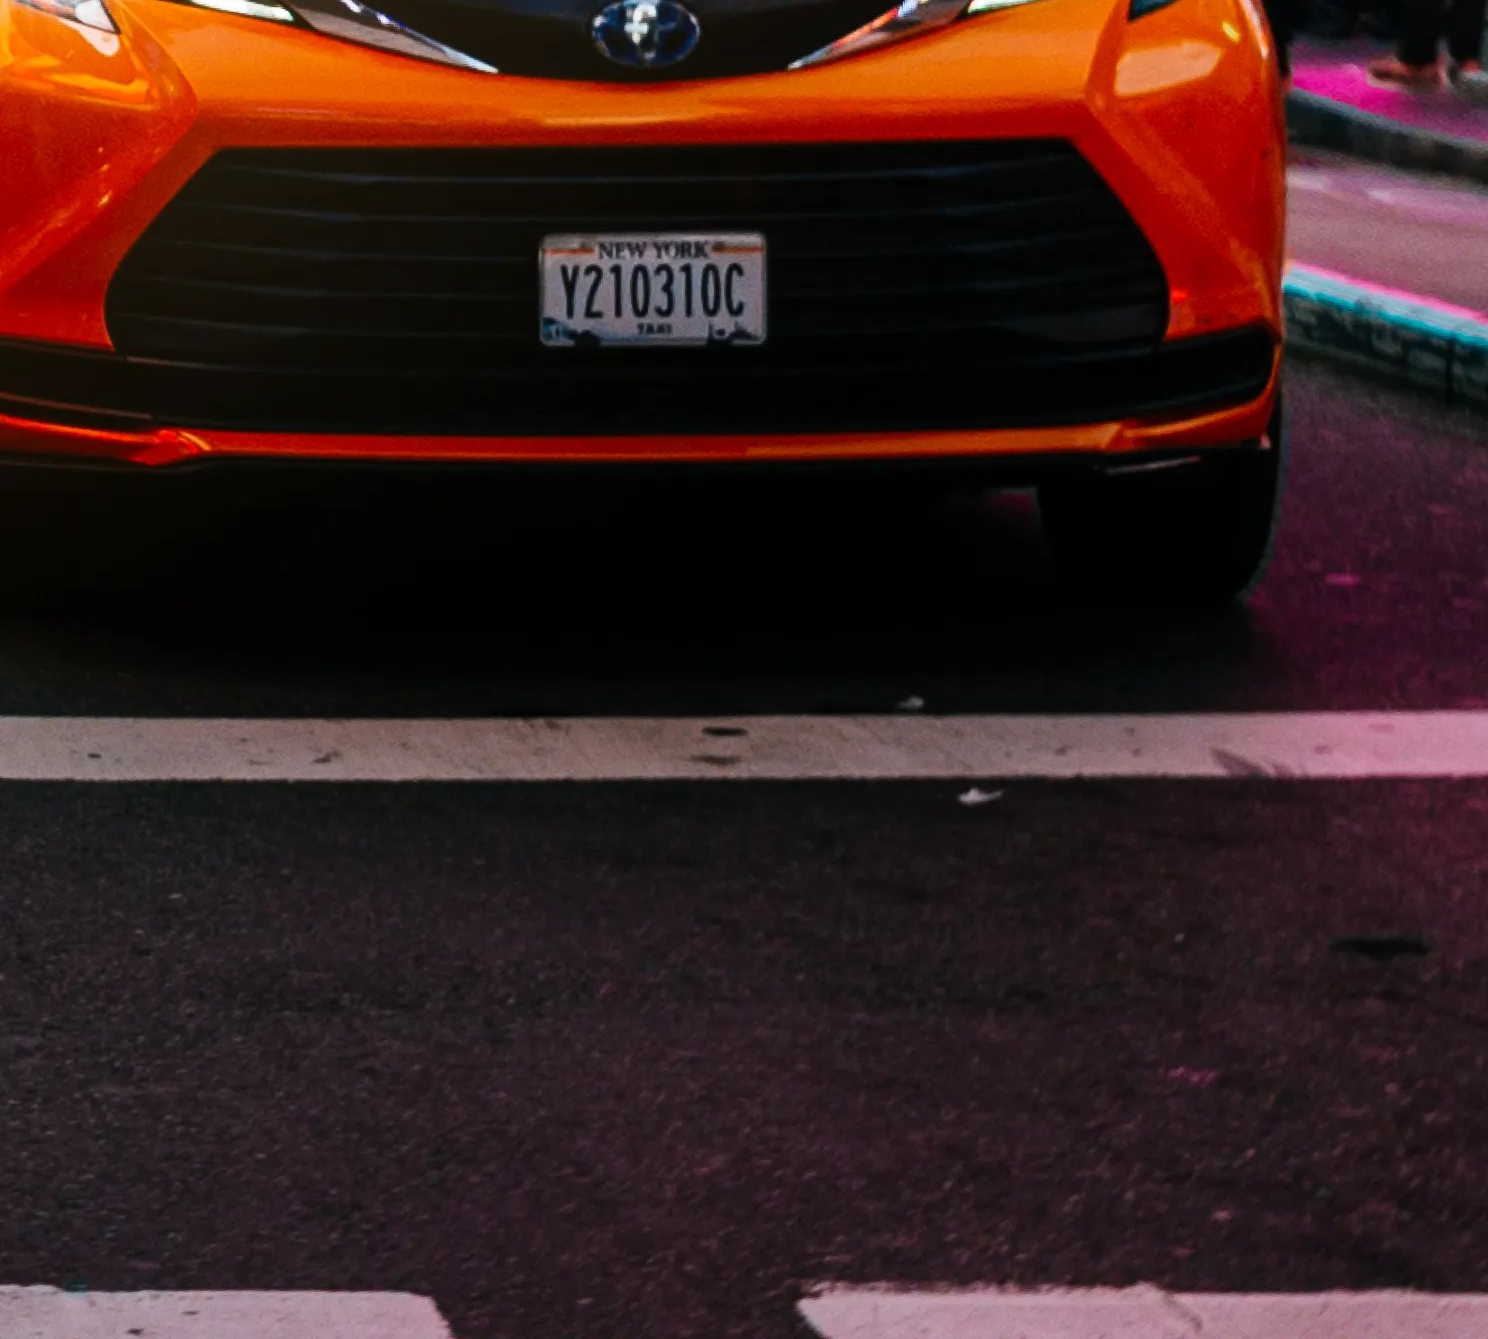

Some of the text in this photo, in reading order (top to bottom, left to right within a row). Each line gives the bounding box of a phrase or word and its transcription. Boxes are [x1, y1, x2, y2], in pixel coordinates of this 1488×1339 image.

[598, 241, 710, 259] NEW YORK
[560, 262, 745, 319] Y210310C
